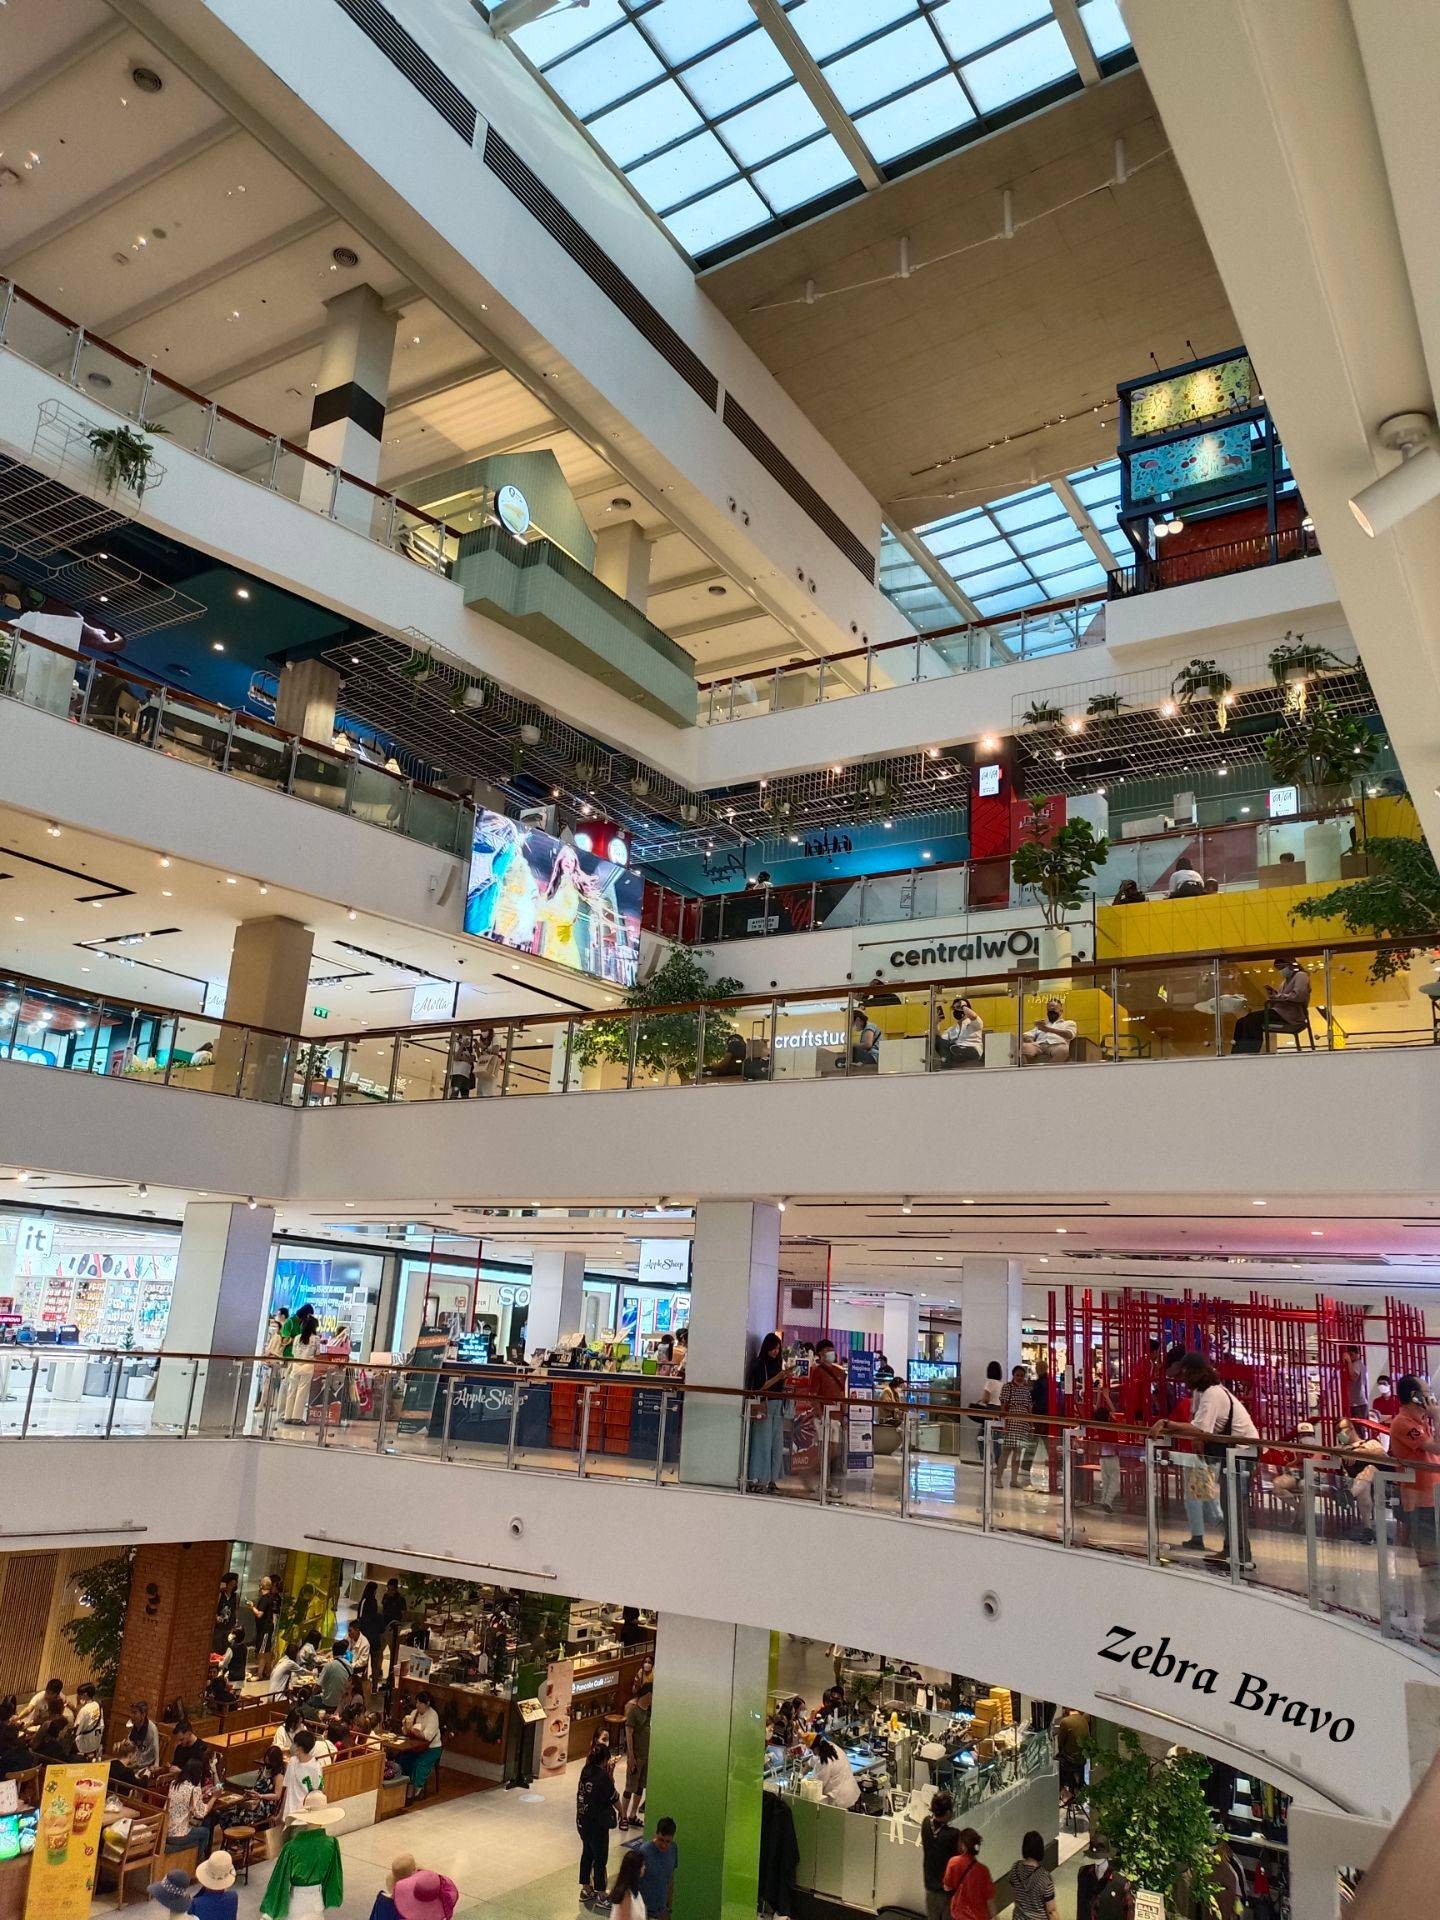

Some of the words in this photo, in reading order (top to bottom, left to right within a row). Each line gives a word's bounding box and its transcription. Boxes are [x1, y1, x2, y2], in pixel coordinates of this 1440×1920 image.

[26, 1225, 46, 1252] it
[1097, 1625, 1220, 1694] Zebra
[1229, 1672, 1355, 1743] Bravo
